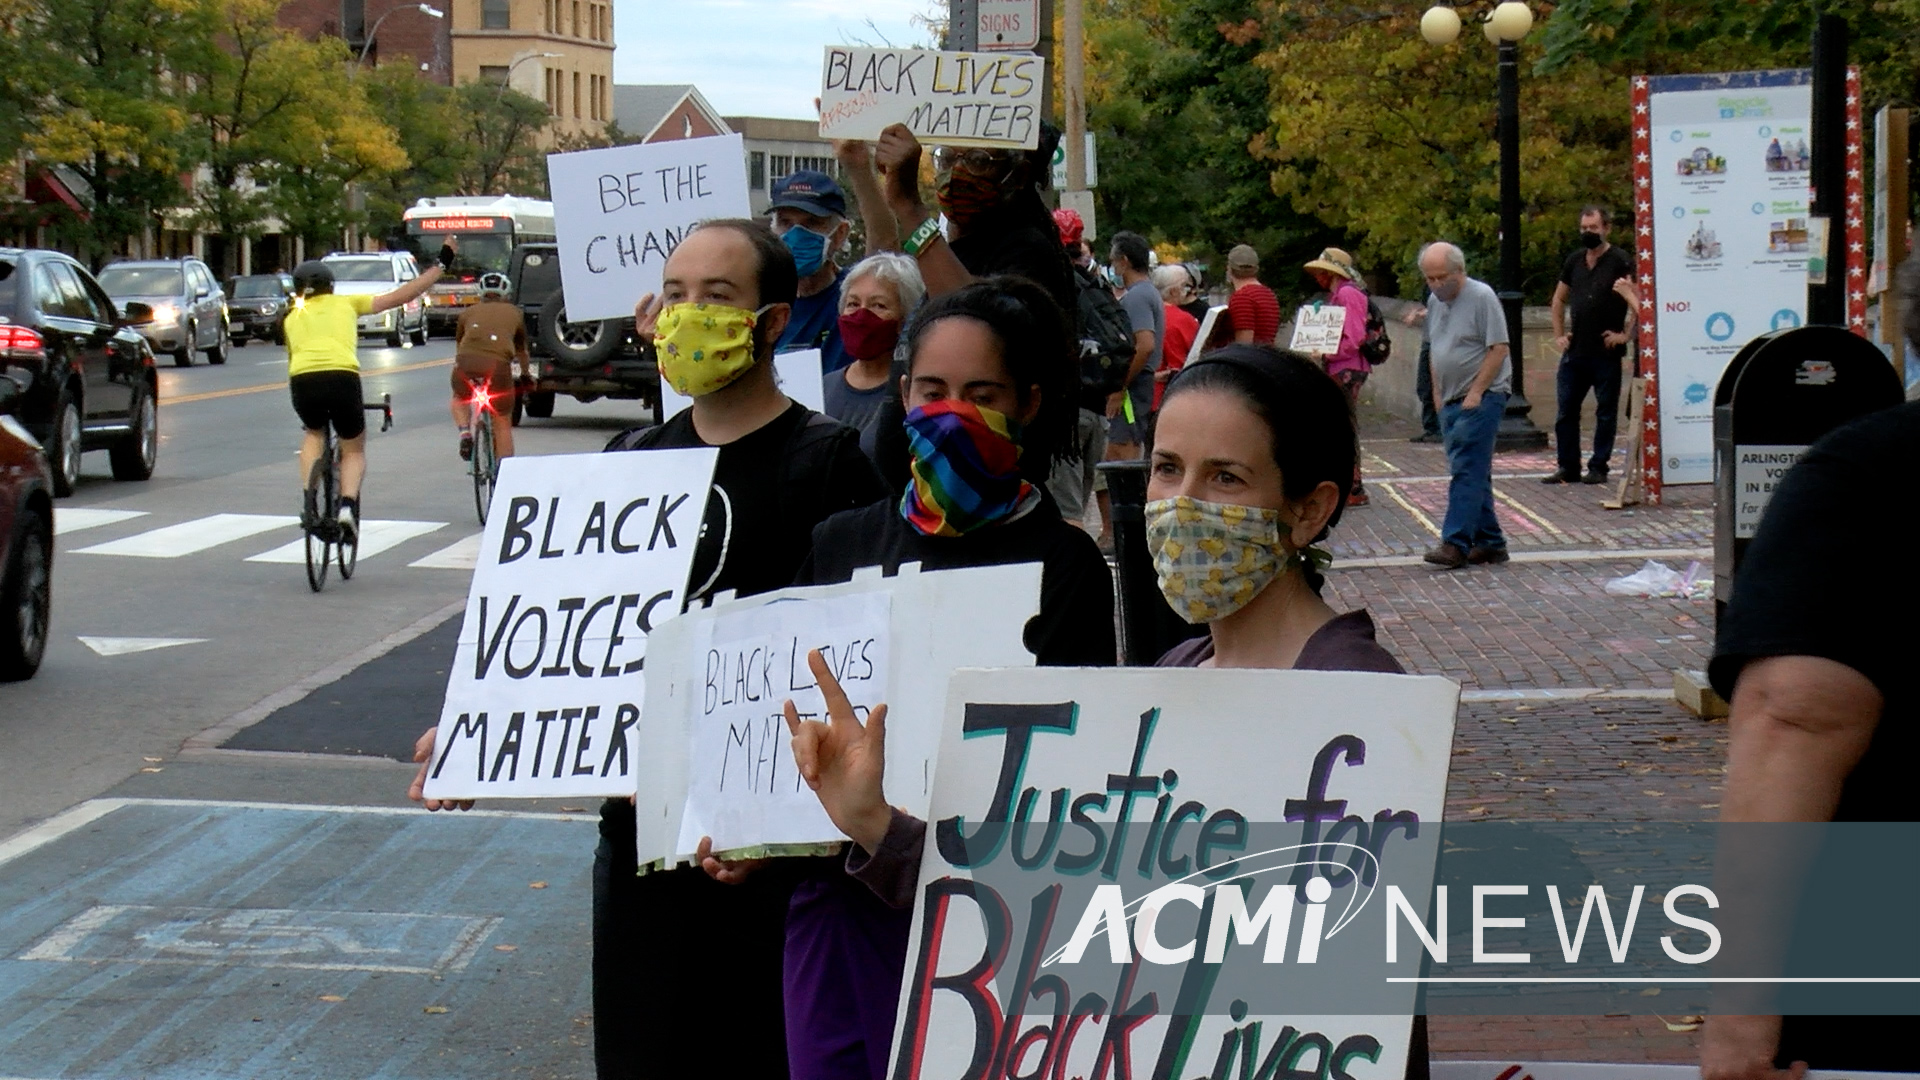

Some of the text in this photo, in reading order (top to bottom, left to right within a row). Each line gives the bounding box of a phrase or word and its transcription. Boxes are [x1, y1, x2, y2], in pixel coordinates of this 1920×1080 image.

[981, 14, 1020, 33] SIGNS
[827, 51, 1034, 98] BLACK LIVES
[905, 102, 1033, 142] MATTER
[598, 164, 713, 214] BE THE
[911, 218, 939, 247] LOV
[1666, 301, 1691, 312] NO!
[1742, 502, 1759, 513] For
[1745, 483, 1760, 493] IN
[498, 493, 690, 565] BLACK
[475, 590, 673, 680] VOICES
[704, 646, 774, 715] BLACK
[431, 703, 640, 782] MATTER
[936, 701, 1419, 905] Justice for
[893, 876, 1383, 1080] Black Lives
